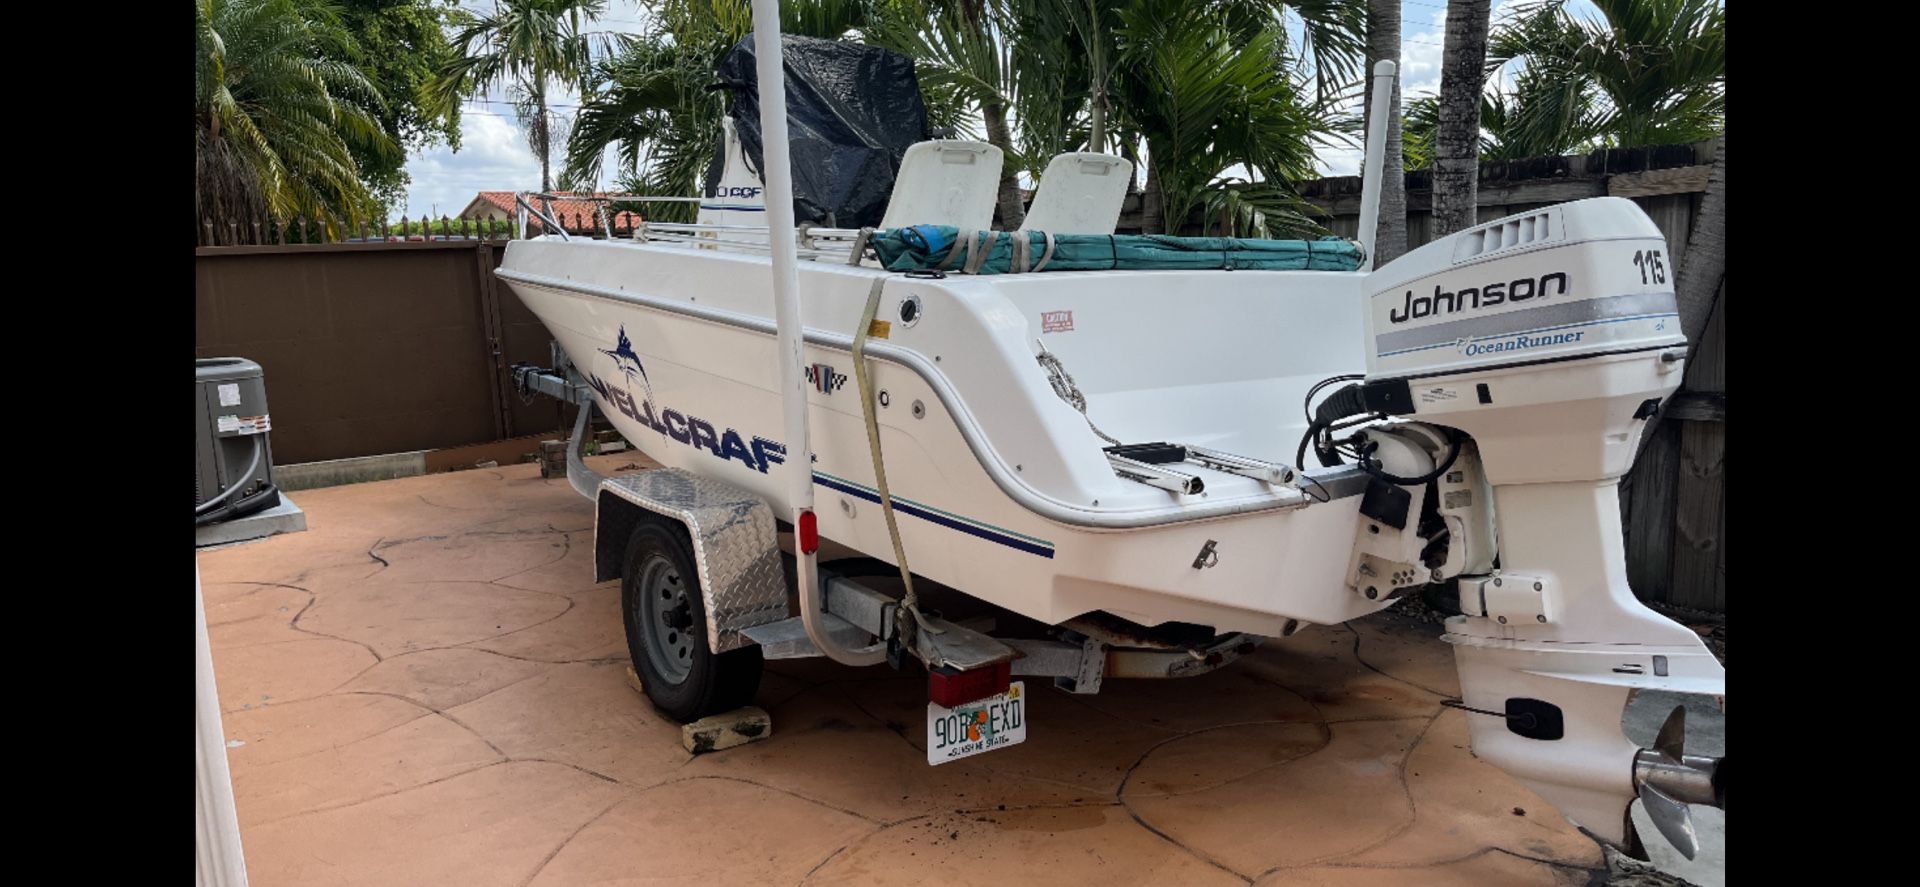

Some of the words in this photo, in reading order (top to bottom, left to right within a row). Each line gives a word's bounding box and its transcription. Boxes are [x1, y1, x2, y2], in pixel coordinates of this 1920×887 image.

[1633, 249, 1666, 285] 115
[1390, 272, 1567, 324] Johnson
[1465, 331, 1584, 357] OceanRunner
[589, 372, 788, 474] WELLCRAF
[935, 712, 969, 749] 90B
[990, 699, 1021, 735] EXD
[951, 740, 984, 757] SUNSHNE
[986, 734, 1006, 748] STATE
